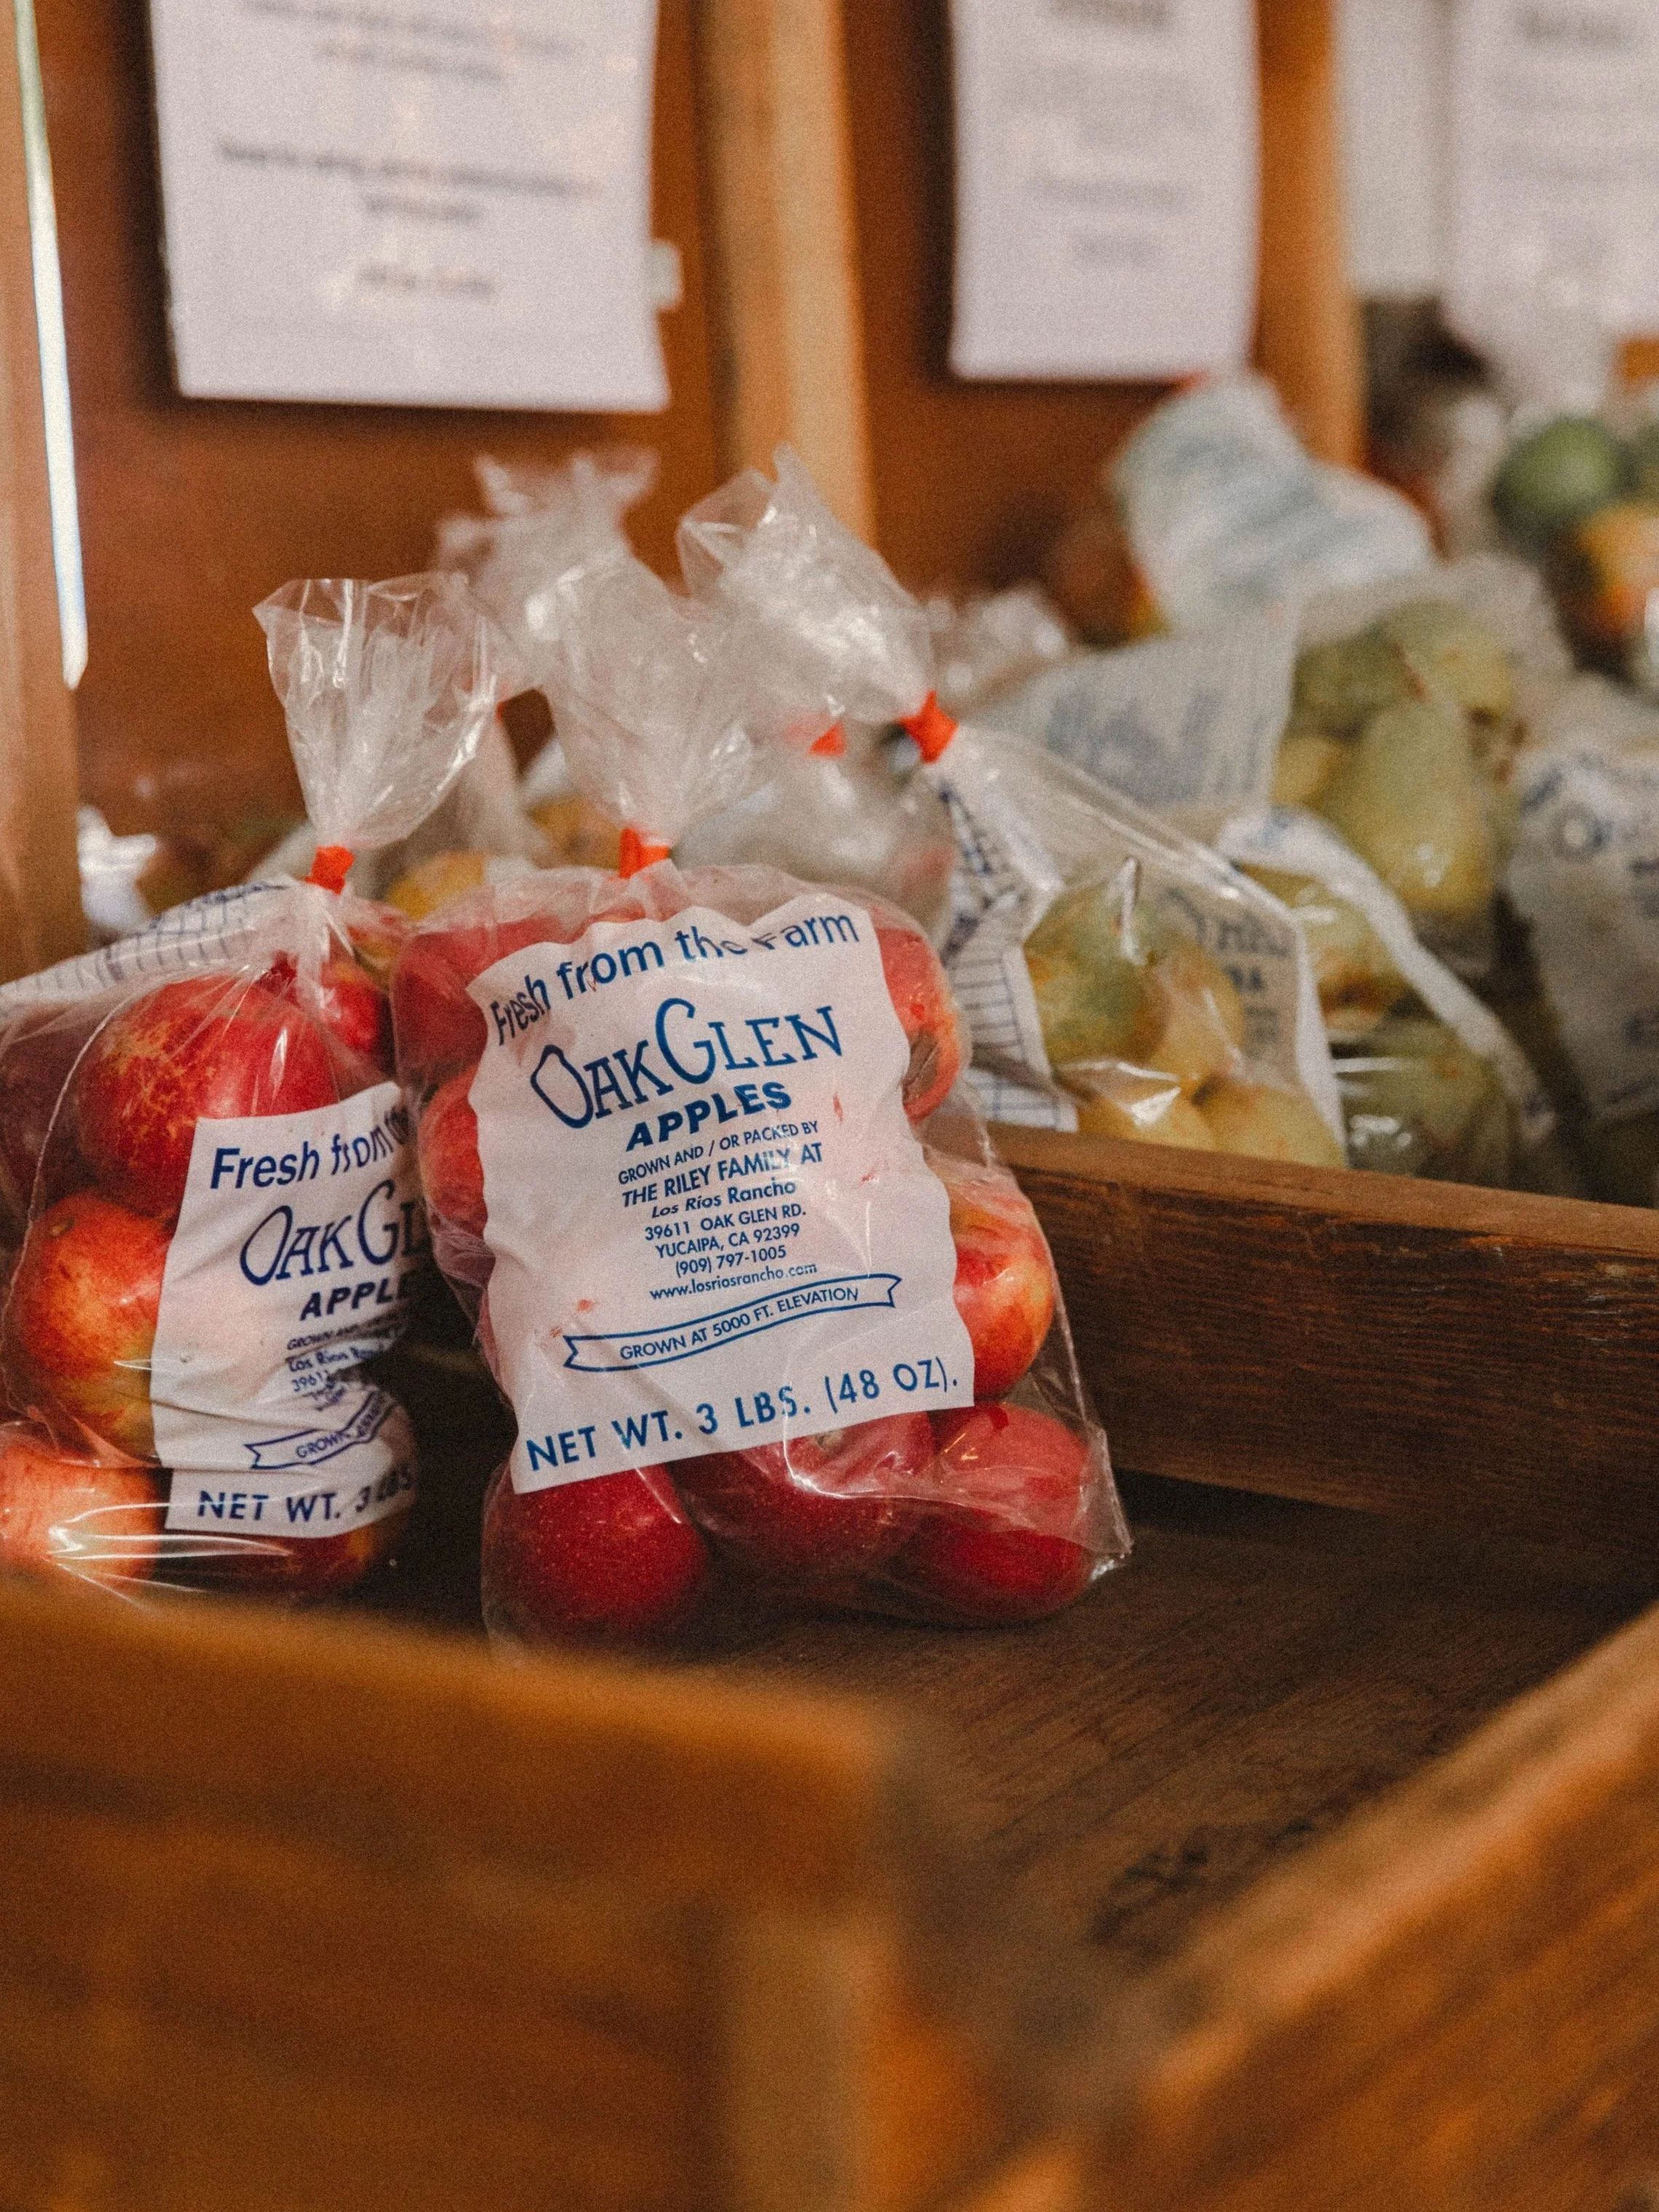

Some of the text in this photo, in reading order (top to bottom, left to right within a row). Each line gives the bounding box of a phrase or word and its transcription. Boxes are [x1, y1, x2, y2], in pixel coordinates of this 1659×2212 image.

[490, 975, 552, 1047] Fresh
[555, 940, 665, 1001] from
[750, 914, 860, 951] Farm
[625, 1081, 792, 1152] APPLES
[210, 1125, 395, 1190] Fresh from
[618, 1154, 671, 1185] GROWN
[673, 1146, 705, 1166] AND
[718, 1136, 740, 1151] OR
[743, 1123, 799, 1144] PACKED
[801, 1120, 818, 1135] BY
[622, 1142, 823, 1208] THE RILEY FAMILY AT
[644, 1202, 807, 1241] 39611 OAK GLEN RD.
[651, 1203, 680, 1218] Los
[727, 1176, 797, 1204] Rancho
[654, 1222, 801, 1259] YUCAIPA, CA 92399
[675, 1244, 787, 1279] (909) 797-1005
[649, 1262, 817, 1301] www.losriosrancho.com
[619, 1287, 859, 1360] GROWN AT 5000 FT. ELEVATION
[526, 1355, 958, 1472] NET WT. 3 LBS. (48 OZ).
[197, 1491, 269, 1520] NET
[285, 1492, 341, 1523] WT.
